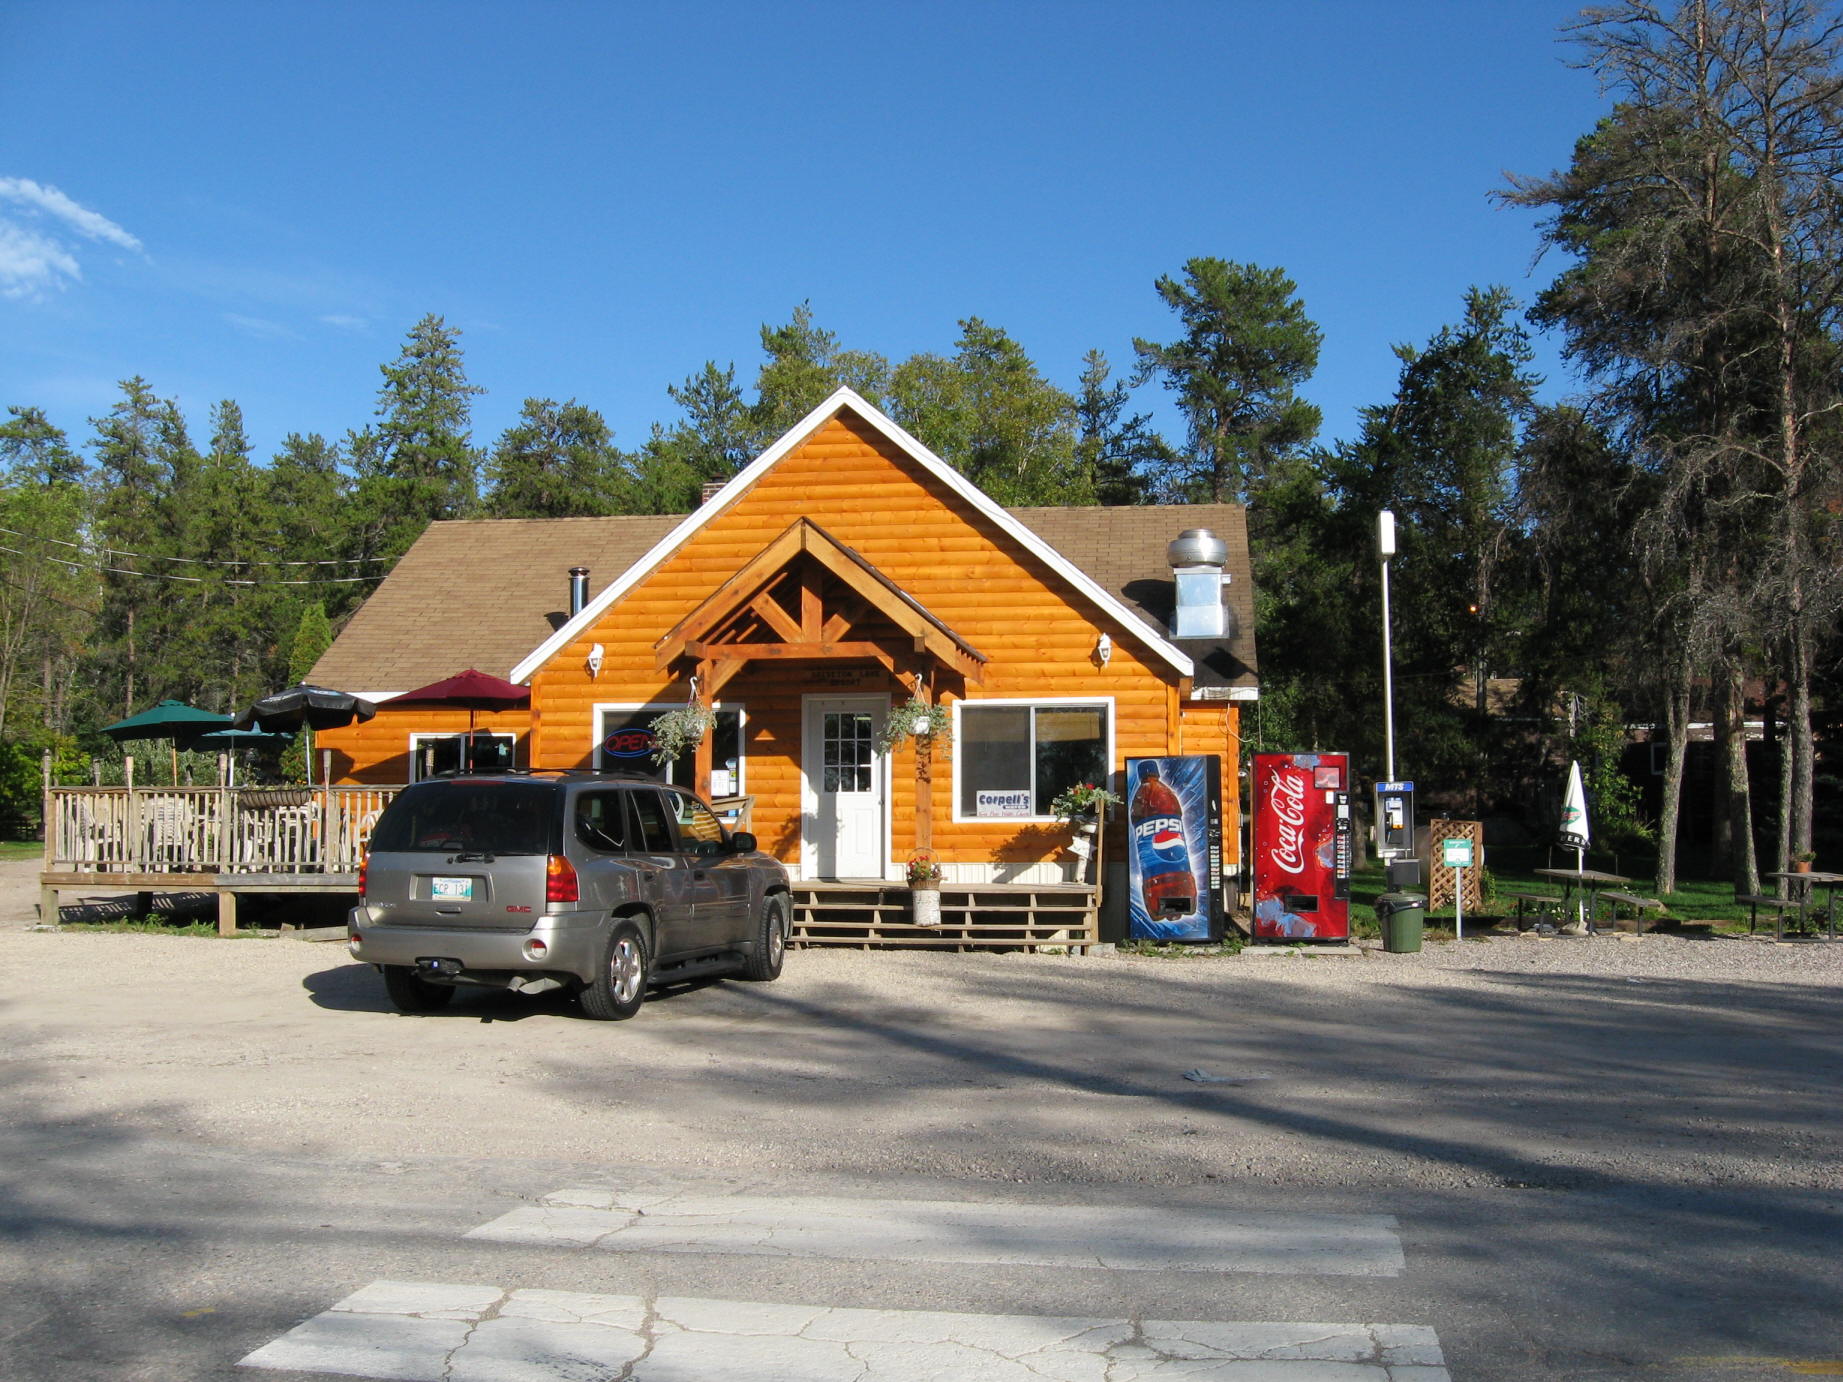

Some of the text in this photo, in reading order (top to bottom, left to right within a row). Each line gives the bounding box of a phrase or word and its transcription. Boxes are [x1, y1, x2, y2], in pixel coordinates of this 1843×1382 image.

[1385, 783, 1405, 791] MTS
[978, 793, 1029, 806] Corpell's
[1135, 818, 1183, 841] PEPSI
[506, 905, 532, 913] GMC
